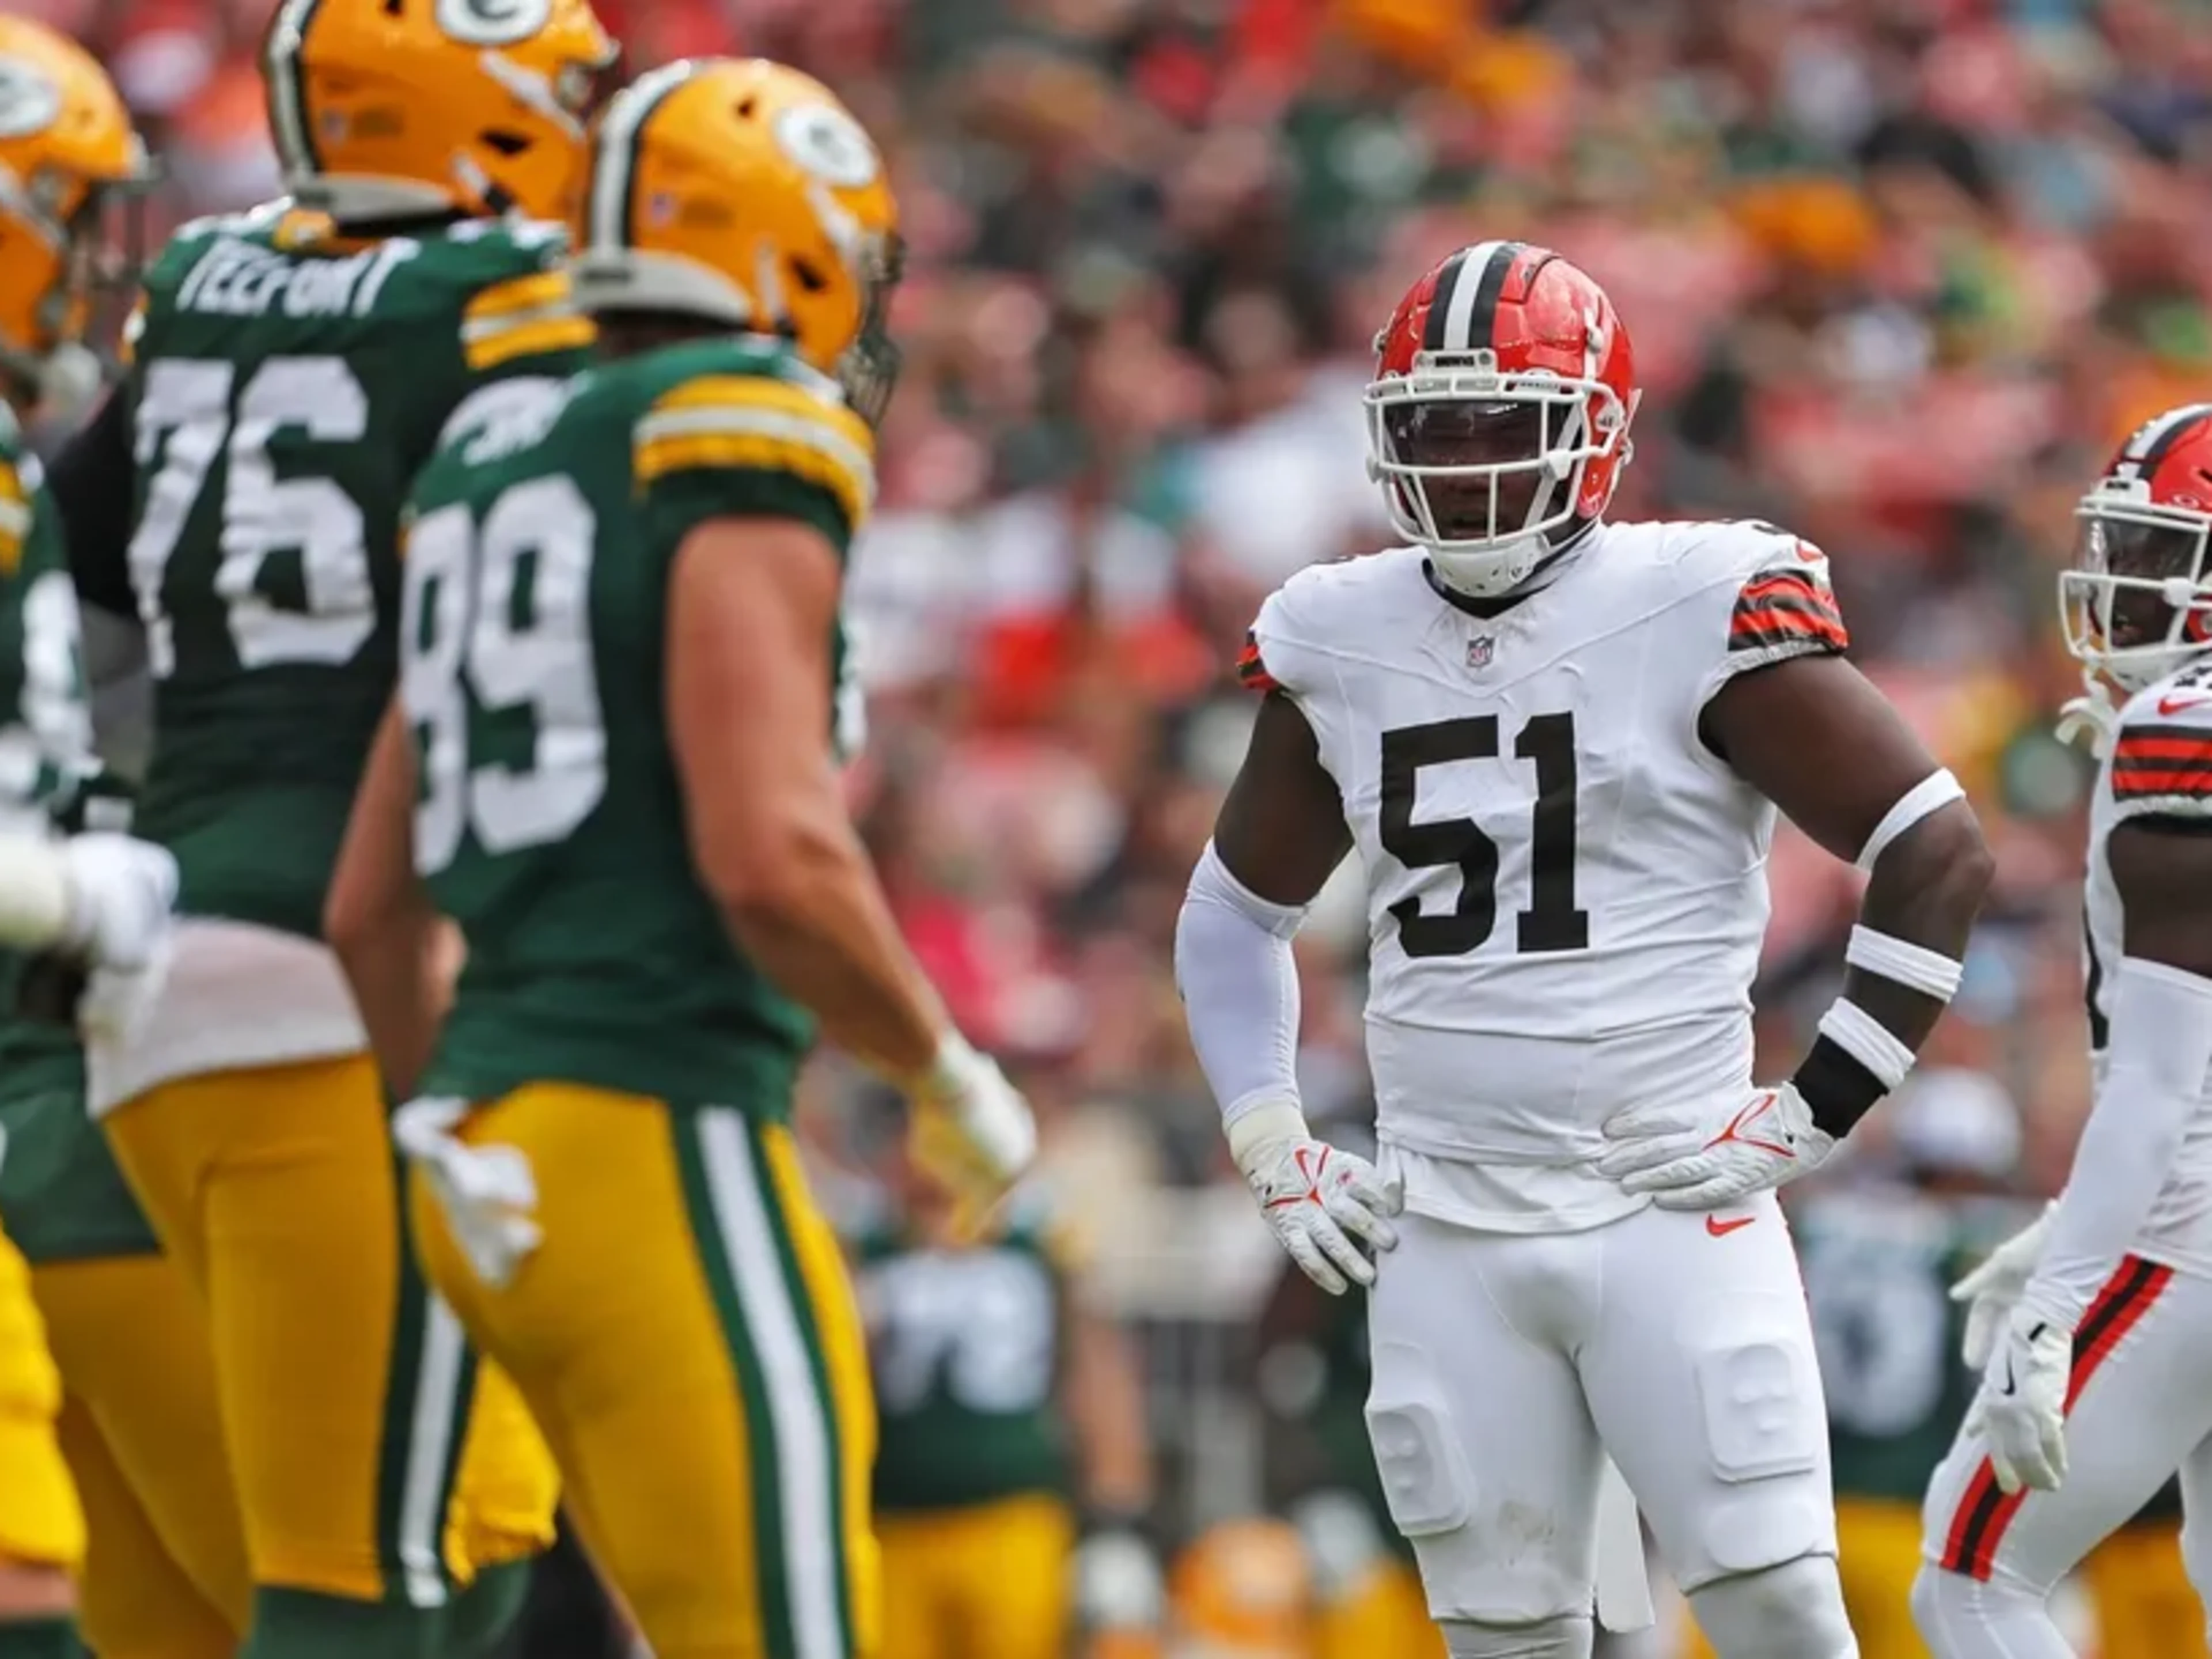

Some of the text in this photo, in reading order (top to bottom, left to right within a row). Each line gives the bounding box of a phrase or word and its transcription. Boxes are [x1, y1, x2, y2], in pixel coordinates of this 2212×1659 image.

[127, 356, 378, 679] 76
[399, 474, 607, 876] 89
[1378, 710, 1589, 957] 51
